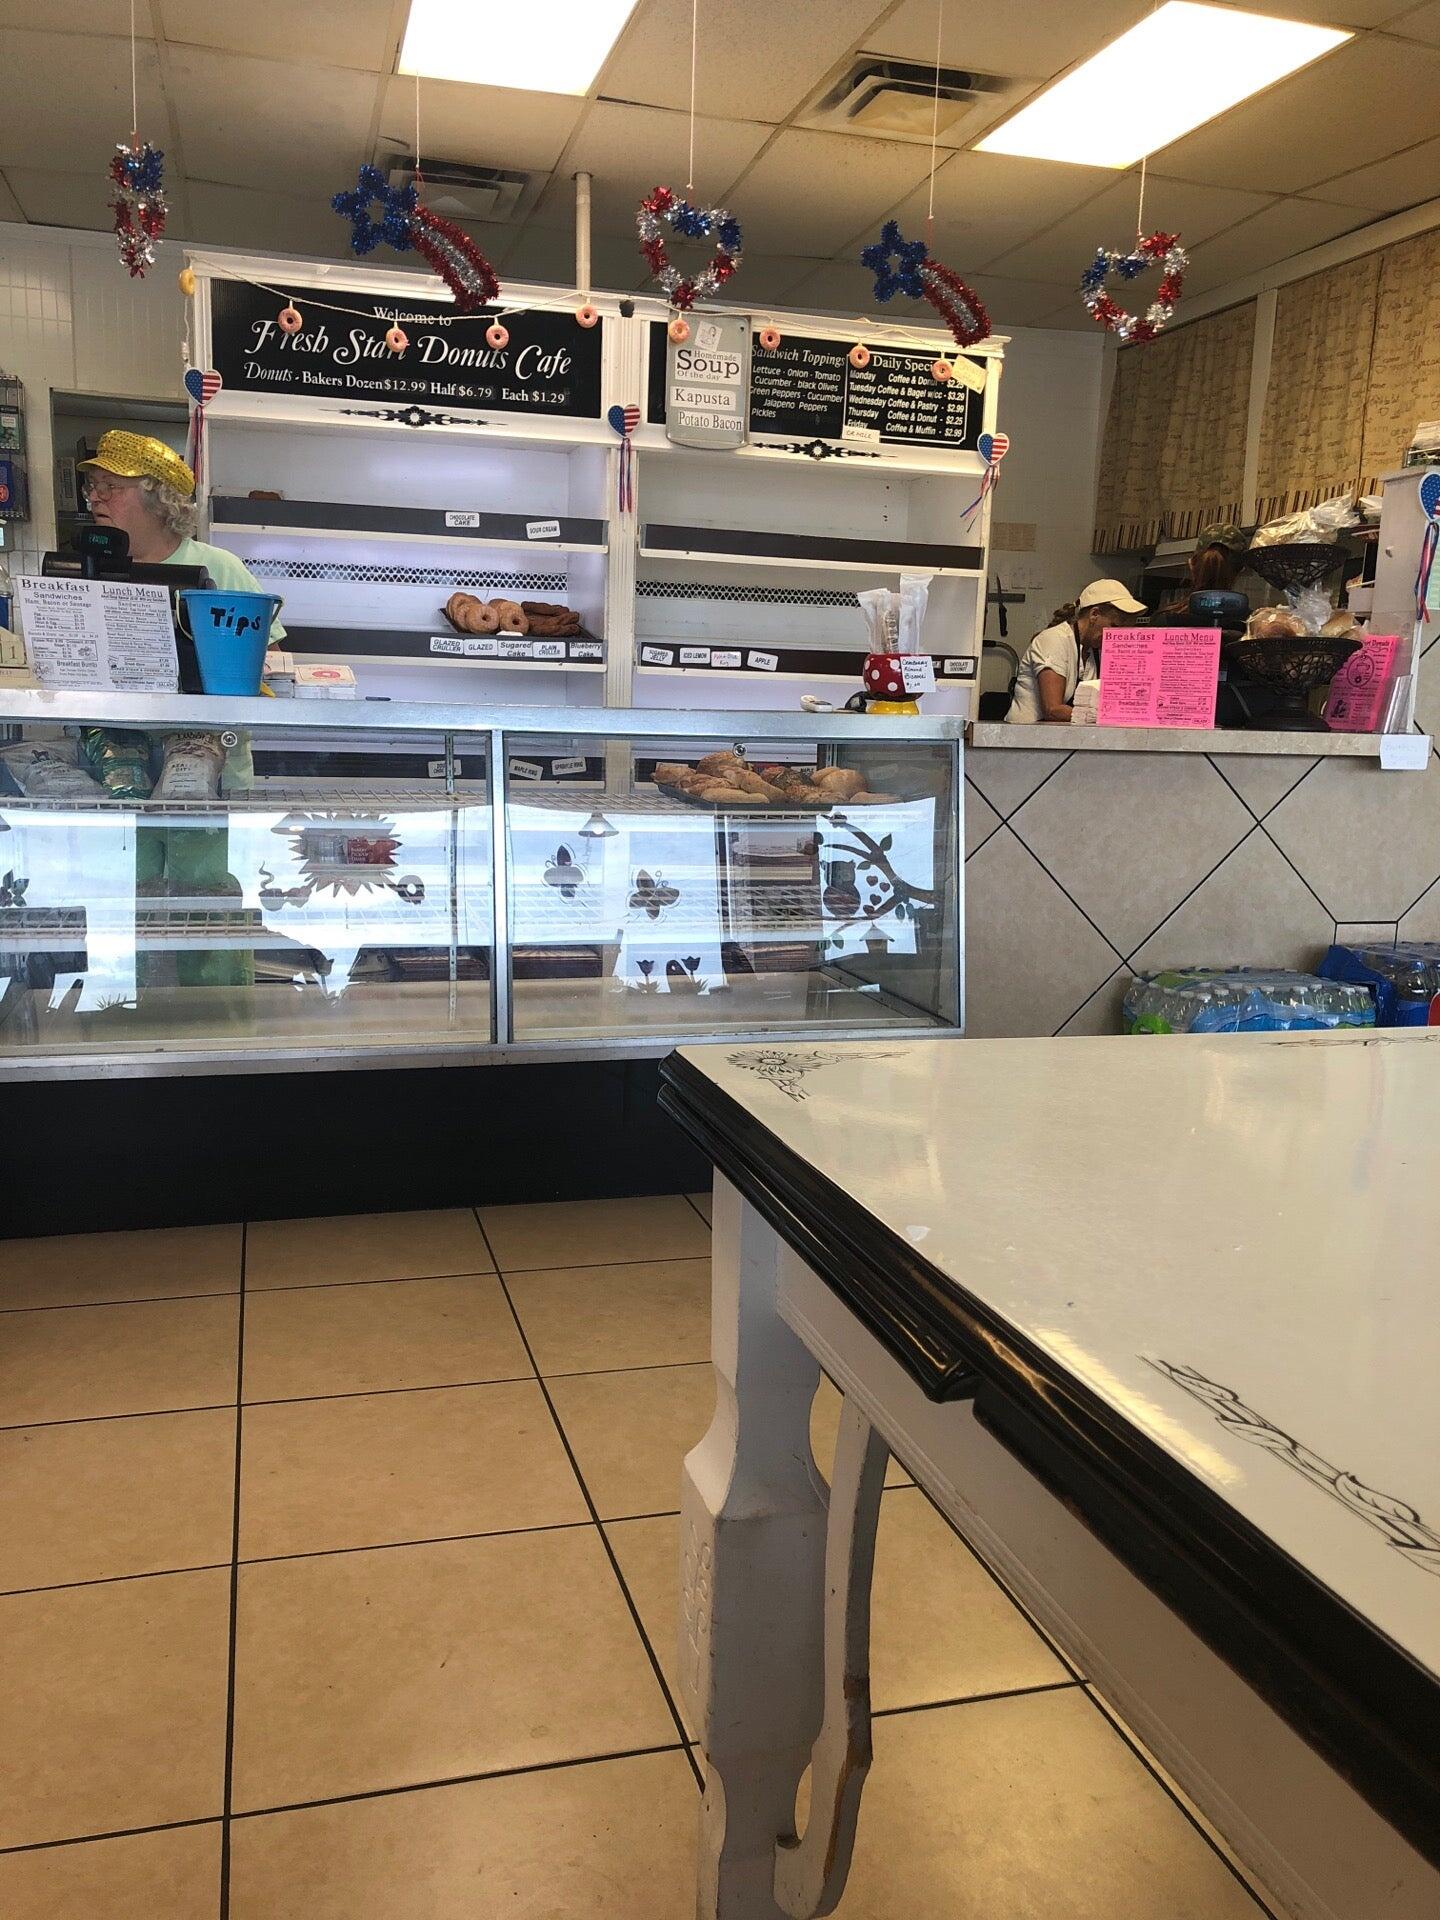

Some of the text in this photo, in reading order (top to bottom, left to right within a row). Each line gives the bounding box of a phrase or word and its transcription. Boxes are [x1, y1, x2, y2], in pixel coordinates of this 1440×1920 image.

[373, 306, 452, 327] Welcome to
[244, 319, 329, 354] Fresh
[417, 335, 509, 370] Donuts
[515, 344, 572, 380] Cafe
[694, 350, 737, 361] Homemade
[751, 344, 846, 368] Sandwich Toppings
[677, 349, 740, 379] Soup
[873, 355, 934, 374] Daily Speci
[690, 371, 704, 379] the
[706, 373, 721, 381] day
[752, 365, 781, 376] Lettuce
[787, 368, 809, 378] Onion
[814, 371, 841, 381] Tomato
[849, 369, 876, 382] Monday
[888, 373, 910, 384] Coffee
[243, 362, 293, 382] Donuts
[302, 371, 343, 387] Bakers
[346, 375, 383, 390] Dozen
[384, 379, 426, 392] $12.99
[430, 382, 457, 396] Half
[458, 385, 492, 398] $6.79
[502, 388, 529, 401] Each
[532, 391, 565, 404] $1.29
[754, 376, 792, 387] Cucumber
[797, 380, 817, 390] black
[817, 382, 839, 392] Olives
[675, 388, 731, 406] Kapusta
[771, 388, 801, 399] Peppers
[807, 392, 844, 403] Cucumber
[849, 382, 876, 394] Tuesday
[877, 385, 899, 395] Coffee
[907, 388, 926, 399] Bagel
[947, 391, 965, 401] $3.29
[763, 399, 828, 412] Jalapeno Peppers
[848, 394, 887, 408] Wednesday
[888, 398, 910, 409] Coffee
[917, 401, 939, 412] Pastry
[947, 404, 964, 413] $2.99
[751, 408, 777, 418] Pickles
[848, 407, 879, 419] Thursday
[887, 410, 910, 421] Coffee
[917, 413, 938, 423] Donut
[946, 416, 963, 426] $2.25
[679, 412, 742, 431] Potato Bacon
[847, 420, 869, 430] Friday
[886, 423, 908, 433] Coffee
[915, 425, 936, 435] Muffin
[945, 428, 962, 438] $2.99
[22, 579, 90, 592] Breakfast
[102, 585, 132, 596] Lunch
[136, 587, 163, 598] Menu
[33, 592, 83, 600] Sandwiches
[210, 606, 261, 637] Tips
[434, 639, 461, 647] GLAZED
[1105, 632, 1155, 641] Breakfast
[1165, 632, 1214, 641] Lunch Menu
[433, 644, 461, 652] CRULLER
[500, 641, 532, 650] Sugared
[570, 643, 602, 651] Blueberry
[755, 656, 771, 666] APPLE
